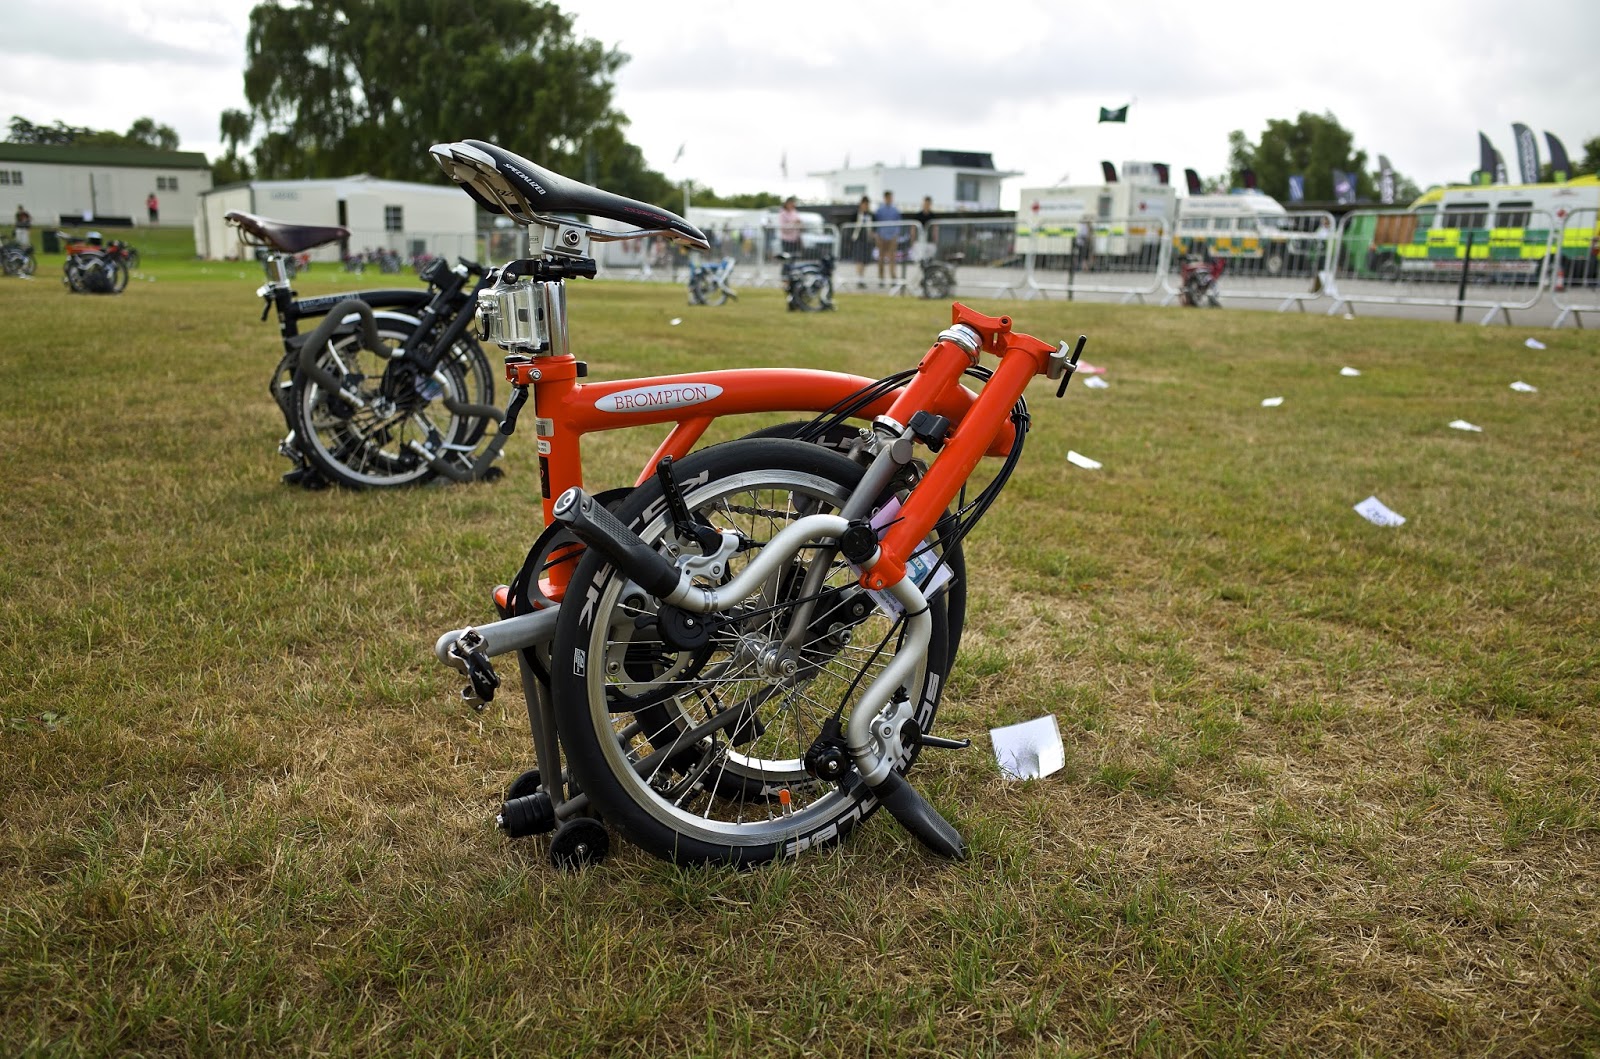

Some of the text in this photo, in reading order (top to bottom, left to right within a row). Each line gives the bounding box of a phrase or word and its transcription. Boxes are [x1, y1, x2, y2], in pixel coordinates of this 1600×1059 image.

[503, 163, 546, 195] SPECIALIZED
[614, 386, 708, 410] BROMPTON
[474, 670, 492, 685] XT
